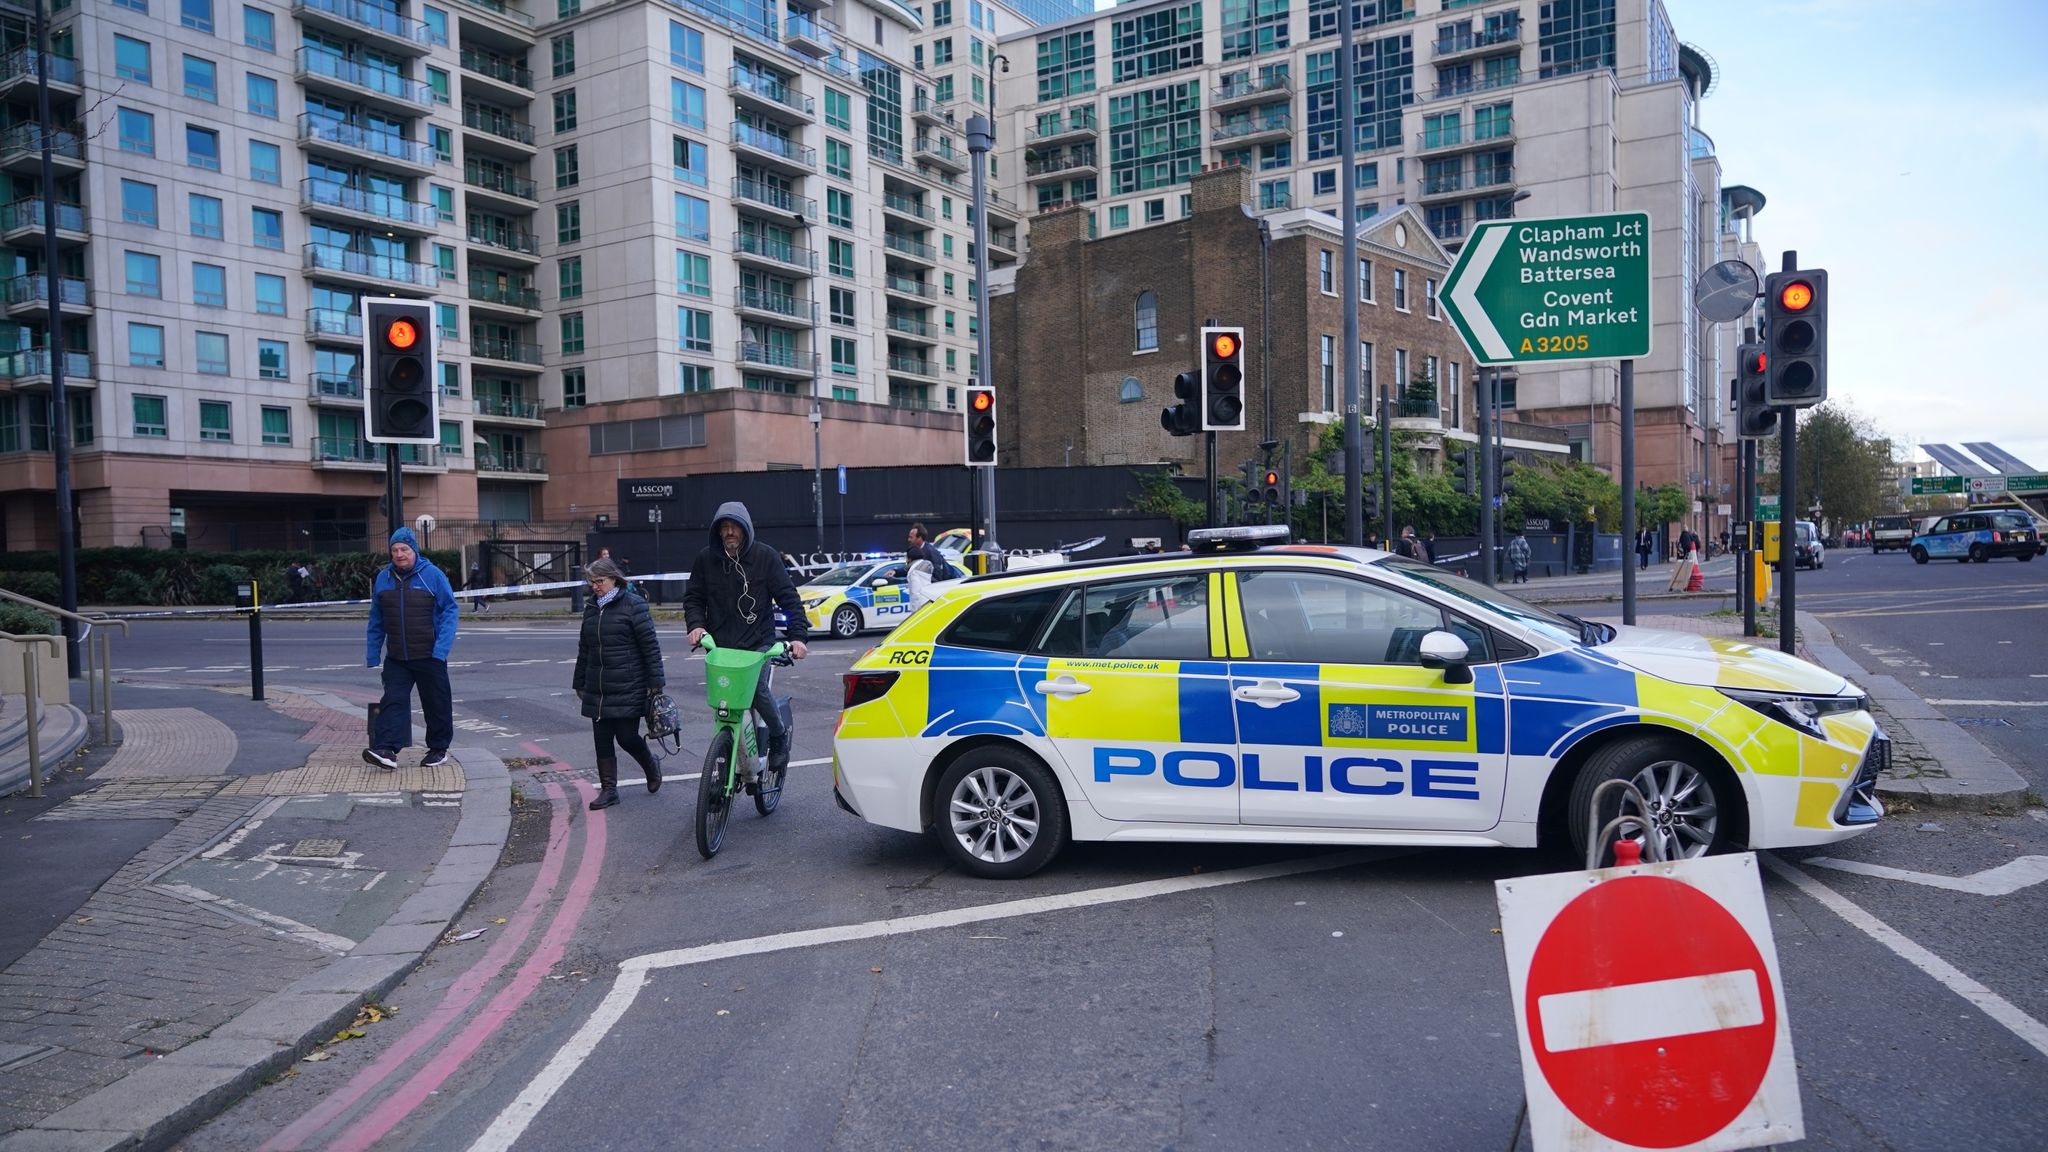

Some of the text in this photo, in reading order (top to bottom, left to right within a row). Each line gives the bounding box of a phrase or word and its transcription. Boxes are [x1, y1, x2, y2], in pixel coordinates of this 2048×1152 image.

[1519, 220, 1642, 244] Clapham Jct
[1519, 241, 1641, 264] Wandsworth
[1520, 266, 1616, 284] Battersea
[1543, 288, 1613, 308] Covent
[1519, 307, 1638, 329] Gdn Market
[1520, 335, 1589, 353] A3205
[631, 485, 664, 494] LASSCO
[876, 604, 912, 616] POL
[889, 650, 930, 665] RCG
[1066, 660, 1159, 670] www.met.police.uk
[1375, 710, 1460, 721] METROPOLITAN
[1387, 723, 1448, 735] POLICE
[1093, 747, 1480, 800] POLICE
